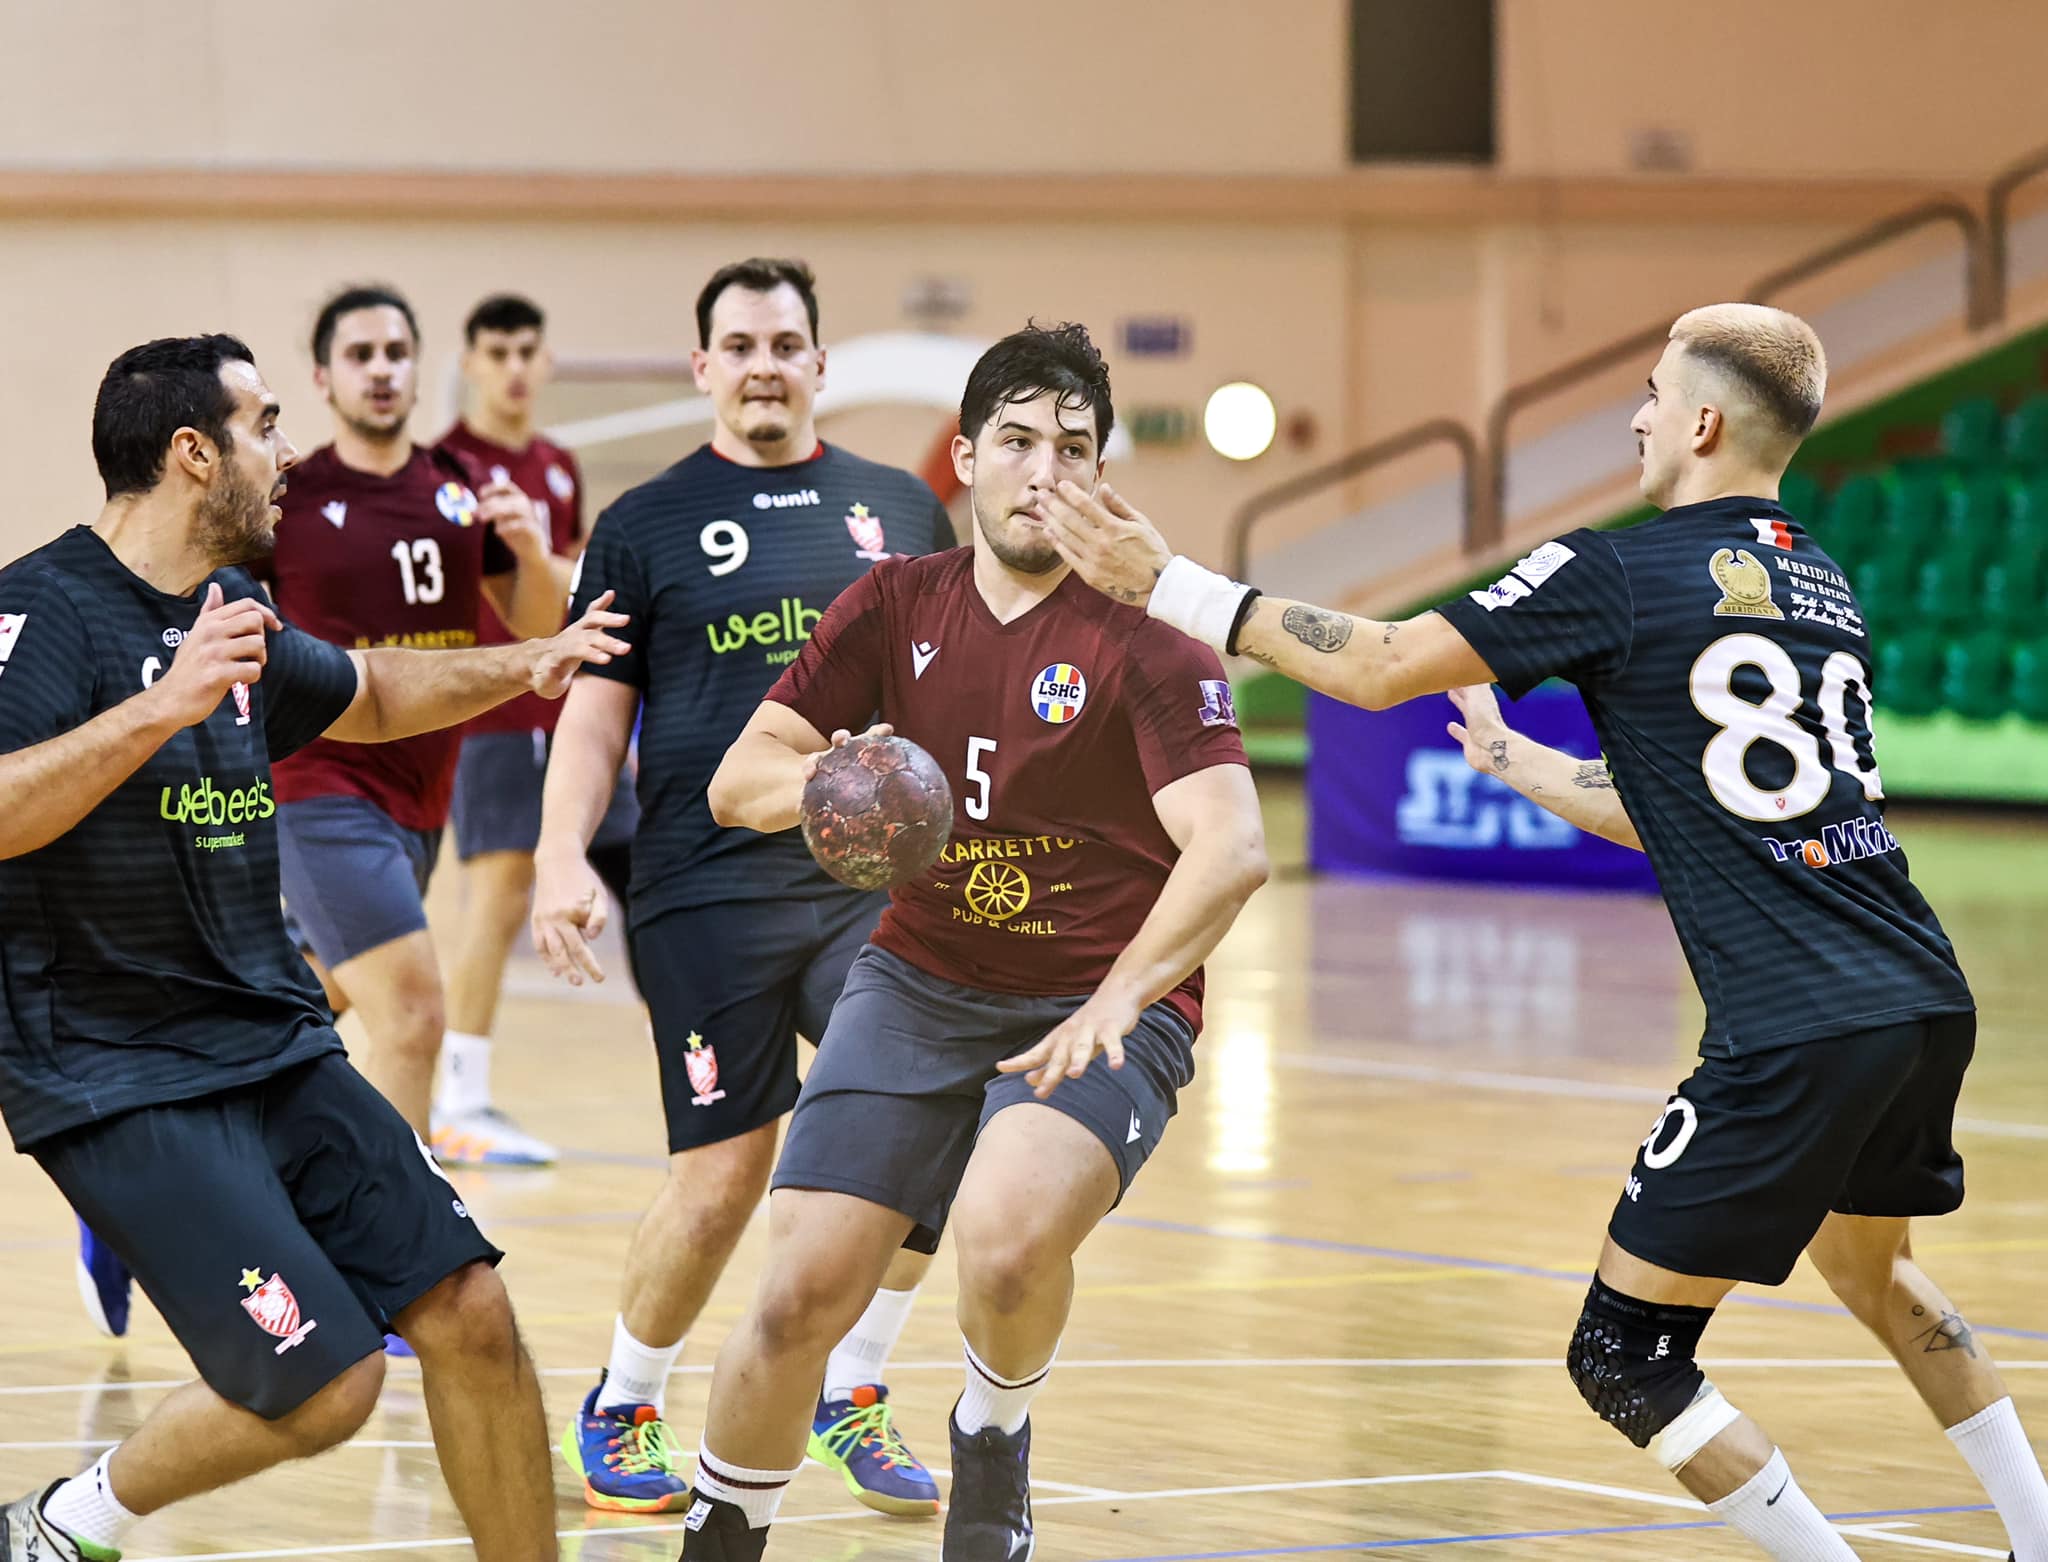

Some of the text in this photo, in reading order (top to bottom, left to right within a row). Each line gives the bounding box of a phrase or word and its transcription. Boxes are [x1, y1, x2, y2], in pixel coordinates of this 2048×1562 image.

[772, 490, 821, 508] unit
[700, 520, 749, 576] 9
[391, 538, 445, 605] 13
[1038, 681, 1080, 699] LSHC
[1689, 632, 1886, 823] 80
[965, 736, 998, 821] 5
[1050, 882, 1073, 893] 1984
[1007, 920, 1057, 935] GRILL
